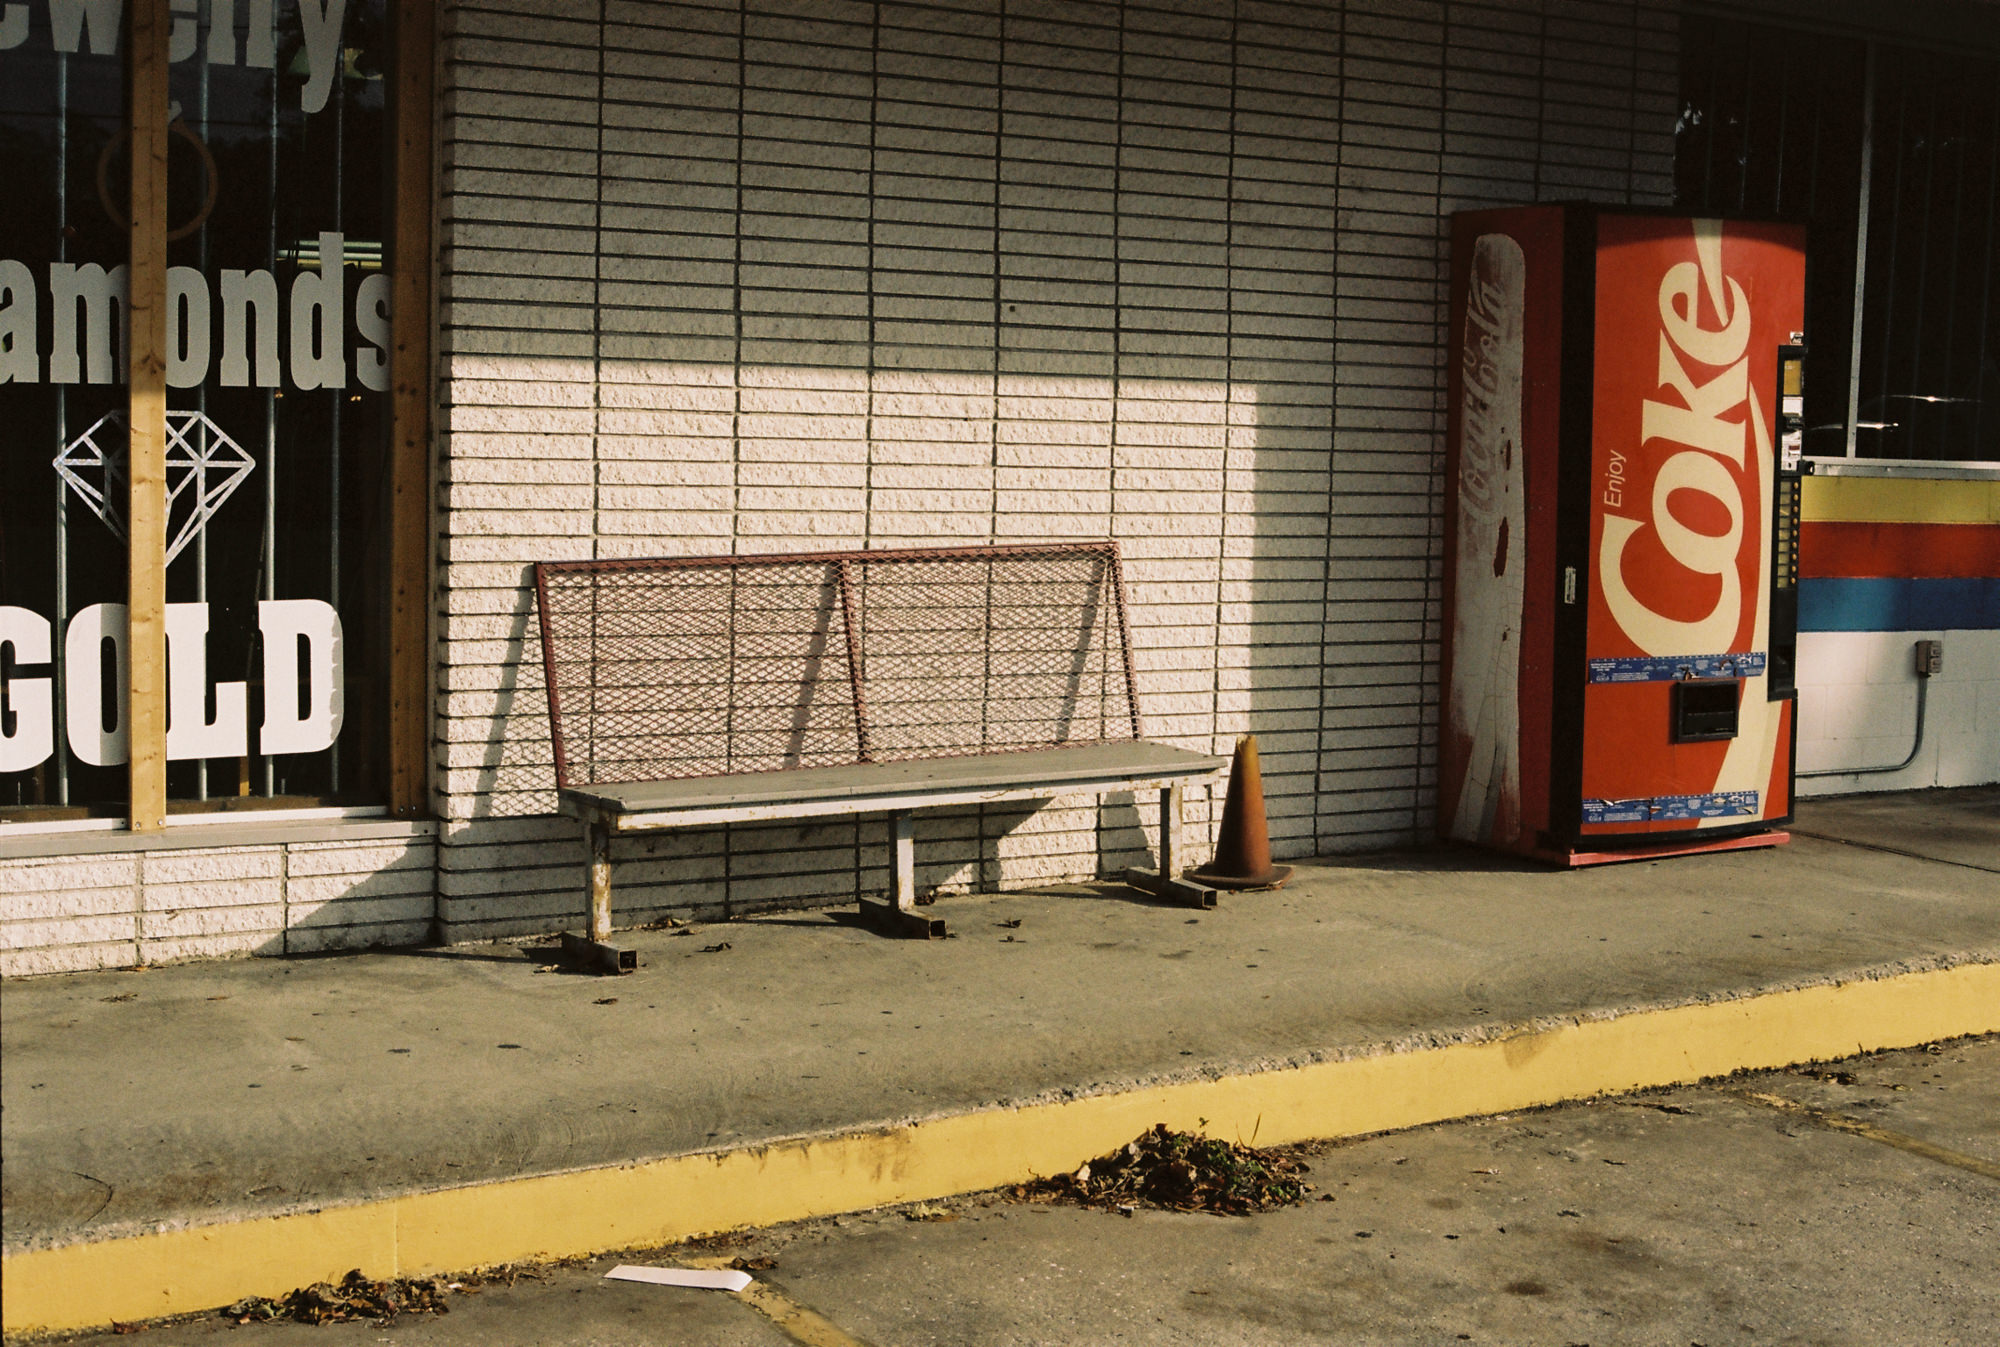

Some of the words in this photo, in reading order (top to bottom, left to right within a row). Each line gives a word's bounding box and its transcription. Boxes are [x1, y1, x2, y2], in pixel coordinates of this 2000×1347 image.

[1599, 260, 1752, 658] Coke
[1603, 449, 1627, 508] Enjoy
[0, 599, 344, 773] GOLD
